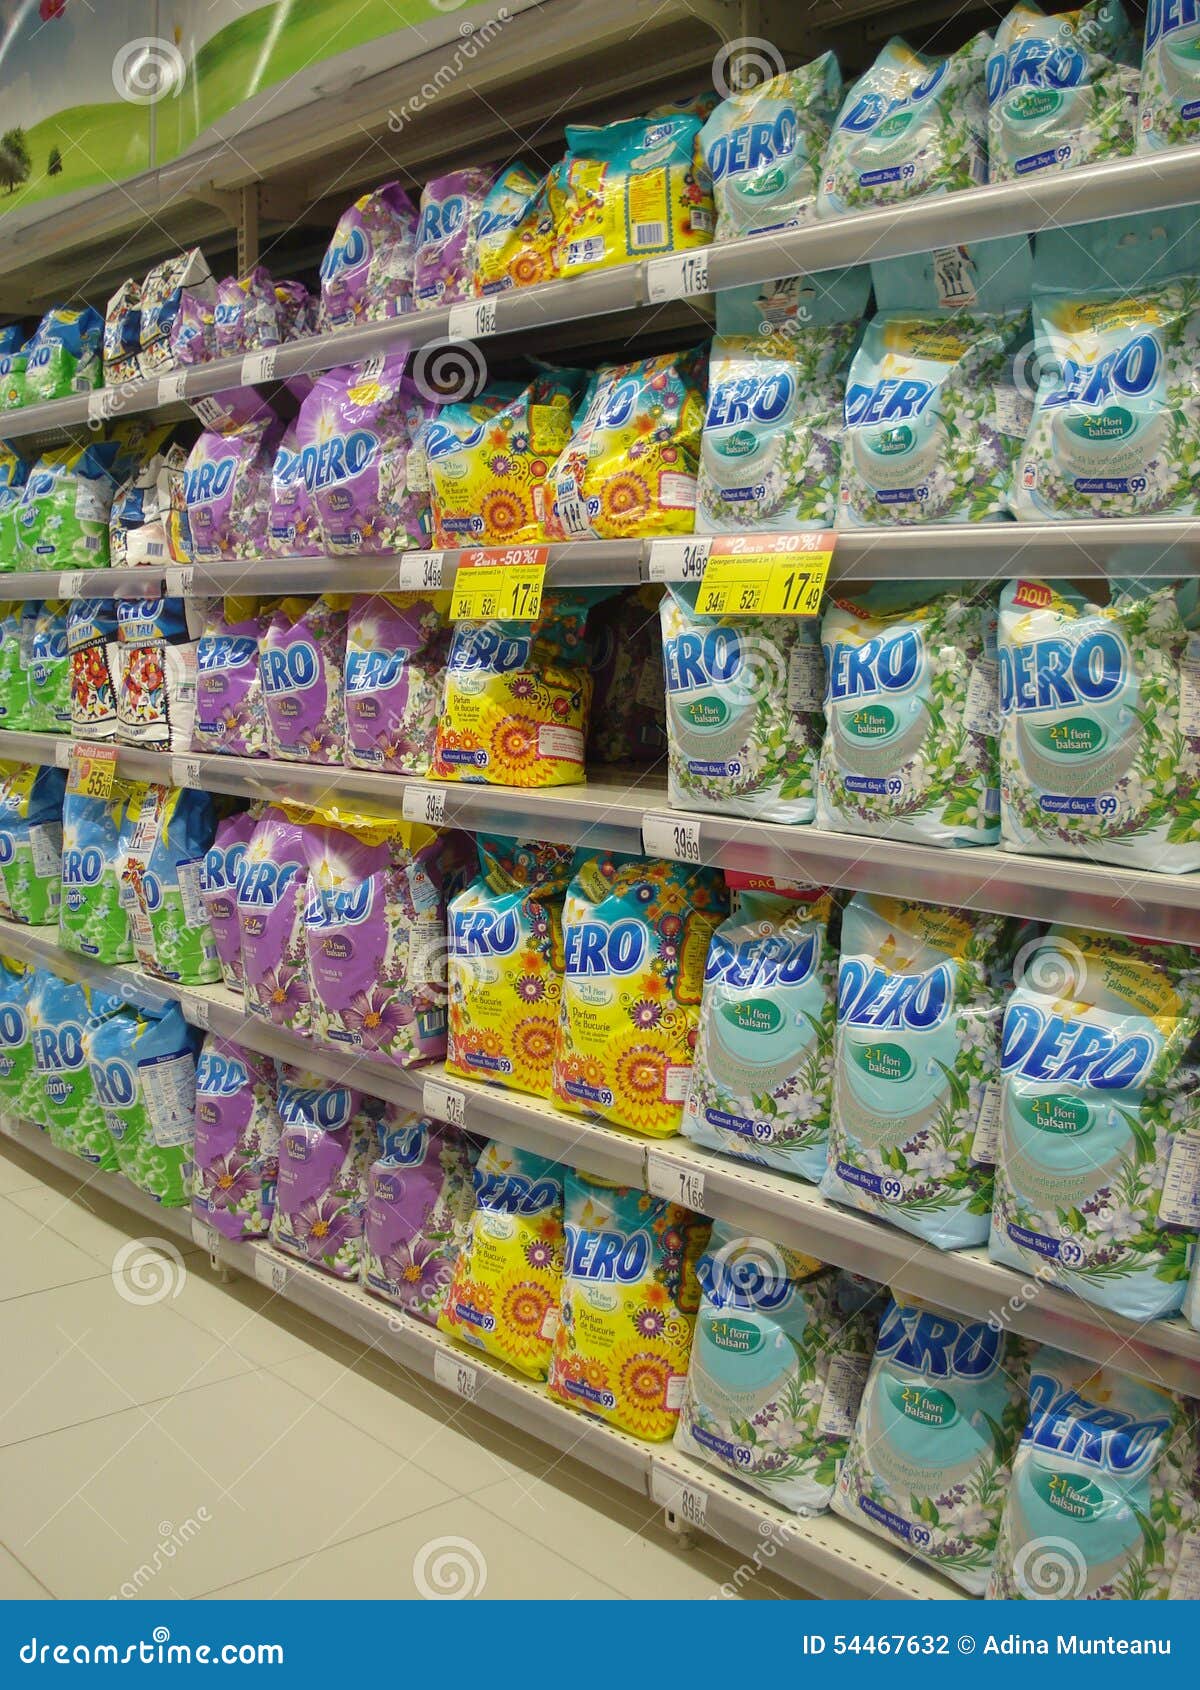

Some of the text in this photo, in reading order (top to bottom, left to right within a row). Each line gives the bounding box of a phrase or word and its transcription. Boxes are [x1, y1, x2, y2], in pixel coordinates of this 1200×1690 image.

[707, 106, 797, 184] DERO
[1058, 145, 1072, 160] 99
[903, 164, 915, 178] 99
[682, 259, 708, 293] 17 55
[704, 370, 797, 432] ERO
[1088, 426, 1124, 437] balsam
[302, 429, 381, 492] DERO
[754, 486, 766, 499] 99
[917, 487, 930, 500] 99
[1131, 478, 1146, 493] 99
[588, 499, 600, 514] 99
[471, 516, 484, 531] 99
[682, 546, 697, 578] 34
[783, 571, 823, 610] 17 LEI 49
[512, 583, 531, 616] 17
[528, 597, 539, 616] 49
[705, 591, 721, 612] 34
[740, 590, 755, 610] 52
[196, 634, 260, 673] ERO
[450, 626, 530, 675] ERO
[259, 641, 319, 695] ERO
[665, 627, 745, 693] ERO
[345, 648, 409, 696] ERO
[1000, 629, 1128, 717] DERO
[704, 704, 719, 715] flori
[693, 713, 721, 724] balsam
[869, 714, 886, 726] flori
[857, 723, 887, 735] balsam
[1071, 728, 1091, 740] flori
[1056, 737, 1093, 750] balsam
[477, 752, 488, 765] 99
[728, 761, 741, 776] 99
[88, 770, 105, 796] 55
[887, 779, 901, 794] 99
[1041, 798, 1071, 809] Automat
[1099, 797, 1117, 814] 99
[674, 826, 699, 861] 39 99
[62, 847, 104, 886] ERO
[200, 842, 250, 893] ERO
[565, 918, 650, 977] ERO
[838, 958, 954, 1032] DERO
[572, 1007, 597, 1021] Parfum
[738, 1015, 771, 1030] balsam
[753, 1008, 771, 1021] flori
[583, 1020, 612, 1032] Bucurie
[33, 1020, 88, 1075] ERO
[1000, 1003, 1156, 1091] DERO
[500, 1061, 512, 1074] 99
[868, 1060, 902, 1078] balsam
[882, 1054, 901, 1068] flori
[195, 1051, 249, 1097] ERO
[89, 1056, 137, 1110] RO
[601, 1091, 613, 1105] 99
[1053, 1105, 1076, 1119] flori
[1036, 1112, 1077, 1130] balsam
[755, 1124, 772, 1139] 99
[680, 1173, 705, 1211] 71 68
[884, 1179, 901, 1197] 99
[1063, 1244, 1082, 1263] 99
[483, 1316, 495, 1331] 99
[579, 1308, 603, 1325] Parfum
[589, 1323, 616, 1337] Bucurie
[729, 1327, 750, 1341] flori
[715, 1335, 750, 1351] balsam
[602, 1392, 614, 1407] 99
[921, 1398, 944, 1414] flori
[904, 1403, 943, 1424] balsam
[1018, 1373, 1174, 1476] DERO
[736, 1448, 751, 1465] 99
[1066, 1487, 1089, 1504] flori
[1050, 1494, 1086, 1517] balsam
[913, 1527, 931, 1545] 99
